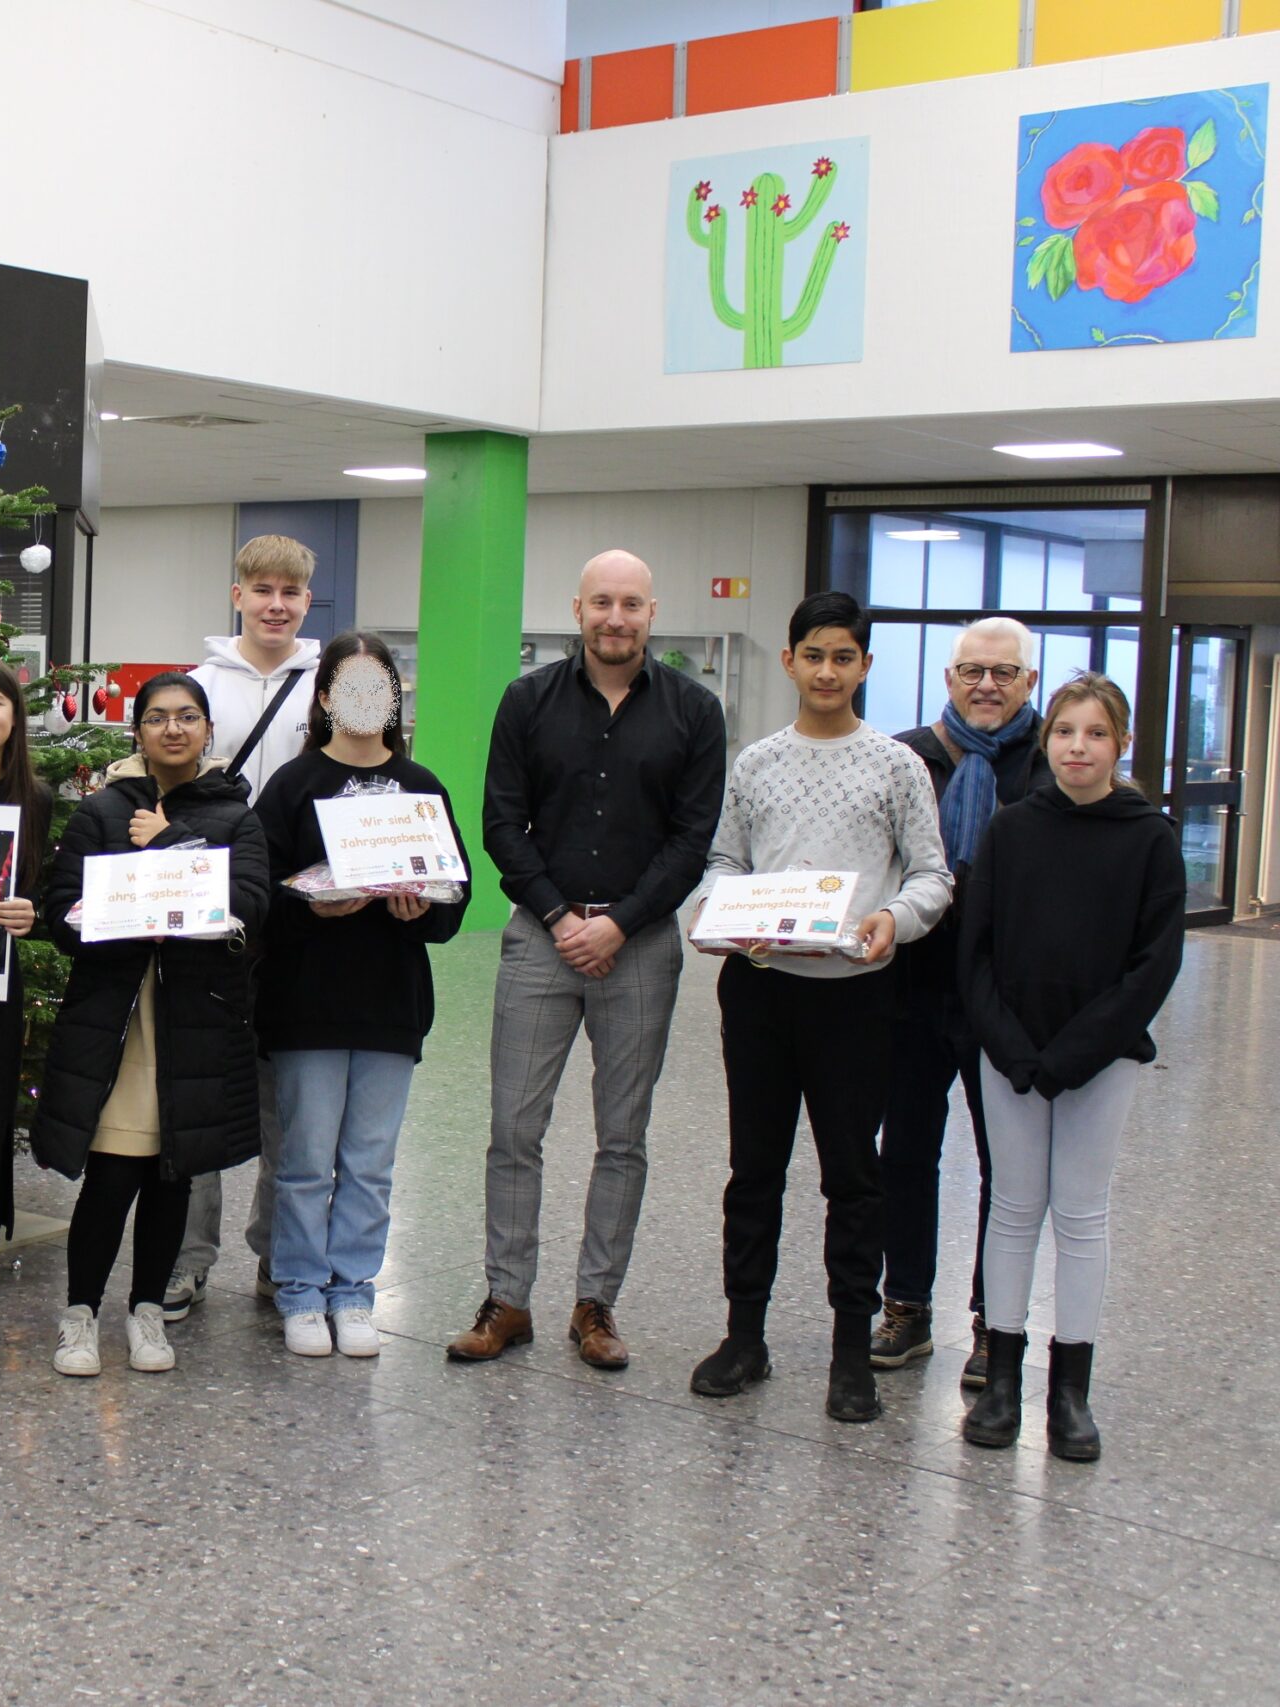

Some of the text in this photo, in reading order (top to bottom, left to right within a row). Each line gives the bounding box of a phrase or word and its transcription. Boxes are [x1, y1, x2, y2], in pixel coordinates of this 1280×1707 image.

[359, 814, 412, 828] Wir sind
[157, 869, 184, 881] sind
[751, 885, 808, 897] Wir sind
